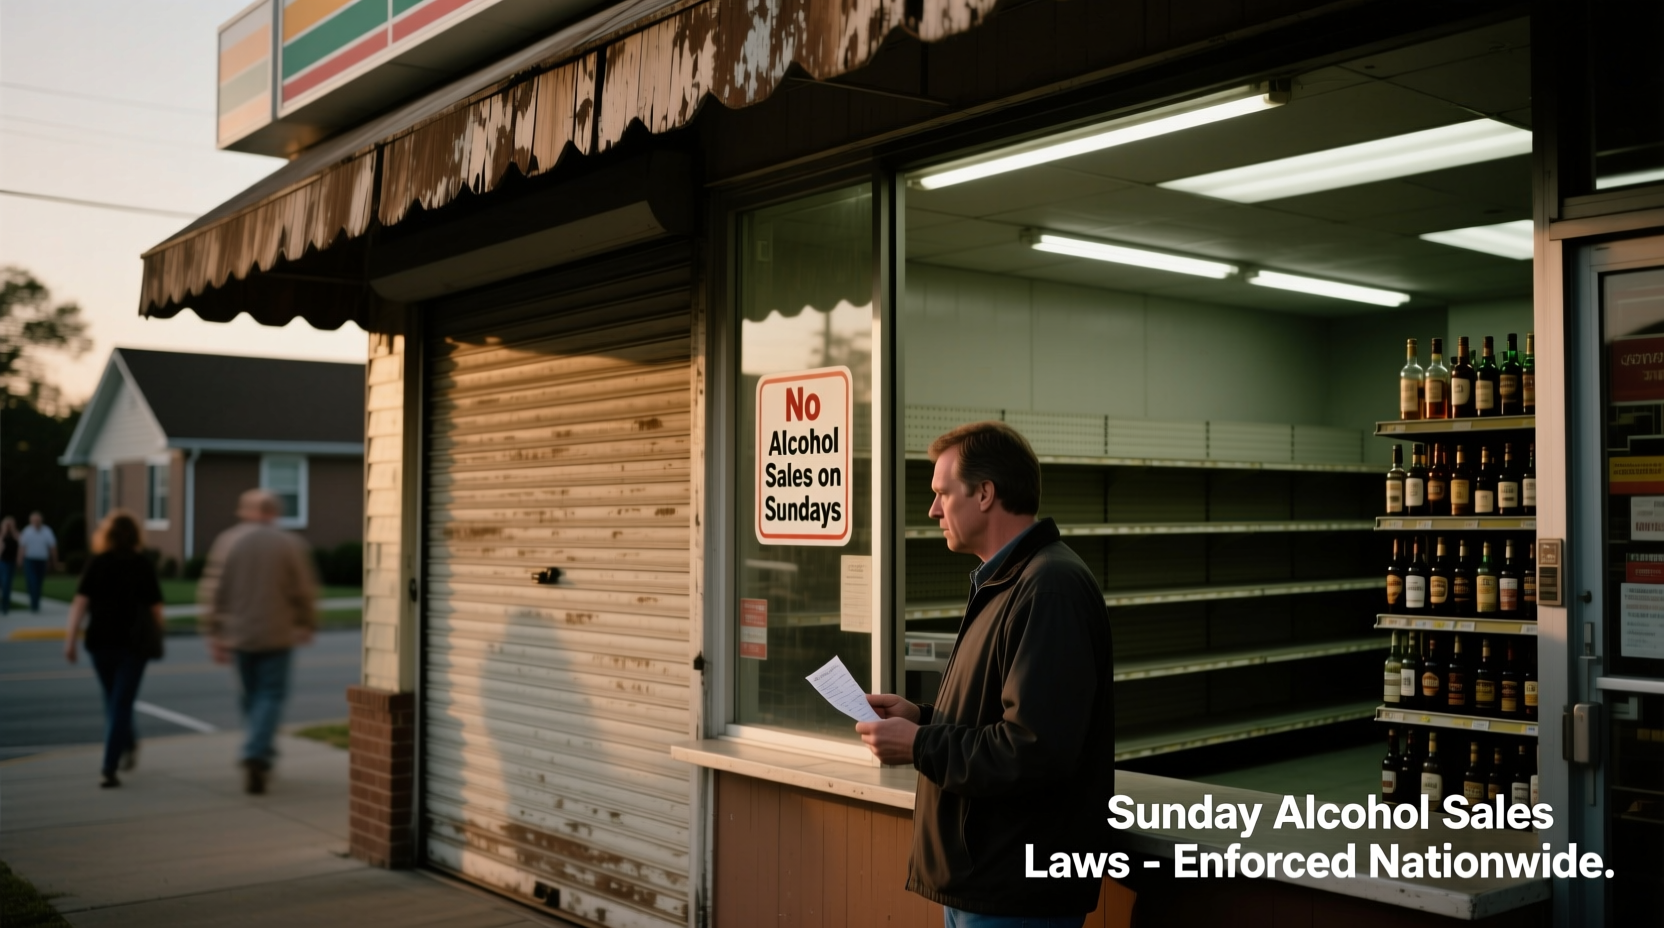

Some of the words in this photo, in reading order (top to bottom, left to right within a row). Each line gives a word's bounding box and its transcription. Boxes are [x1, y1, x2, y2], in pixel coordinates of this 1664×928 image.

[786, 386, 821, 422] No
[768, 426, 839, 456] Alcohol
[765, 462, 813, 488] Sales
[818, 466, 842, 487] on
[765, 495, 842, 529] Sundays
